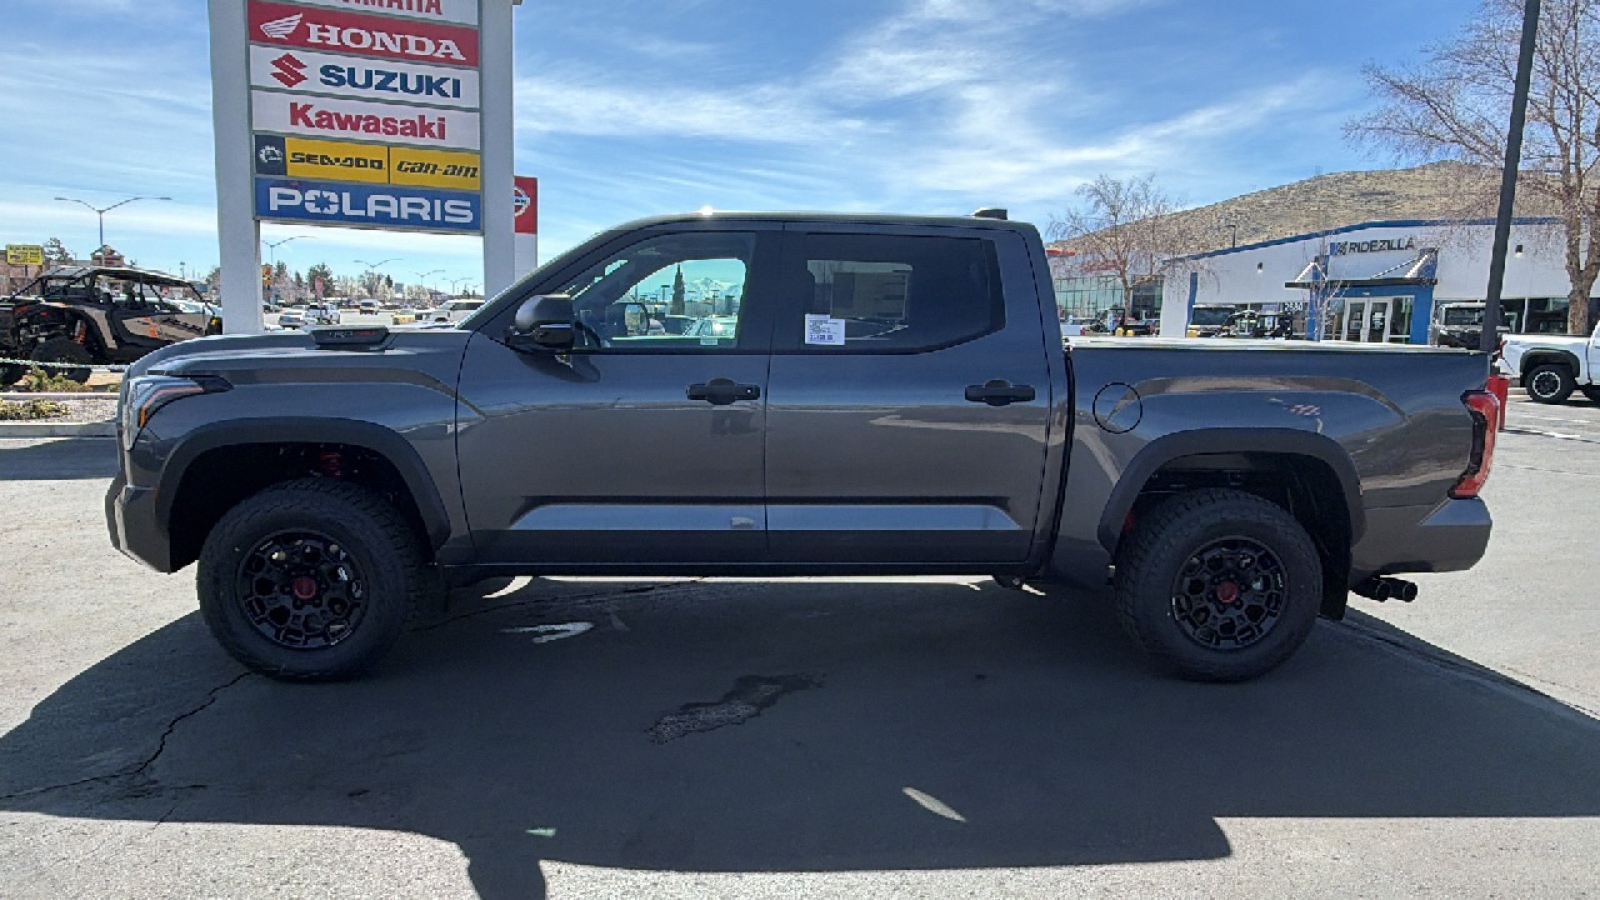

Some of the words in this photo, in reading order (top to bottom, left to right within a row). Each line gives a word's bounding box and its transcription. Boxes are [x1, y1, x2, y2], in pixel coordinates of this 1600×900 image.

[306, 22, 466, 60] HONDA
[320, 64, 460, 98] SUZUKI
[290, 102, 446, 140] Kawasaki
[269, 186, 474, 223] POLARIS
[1349, 236, 1415, 253] RIDEZILLA
